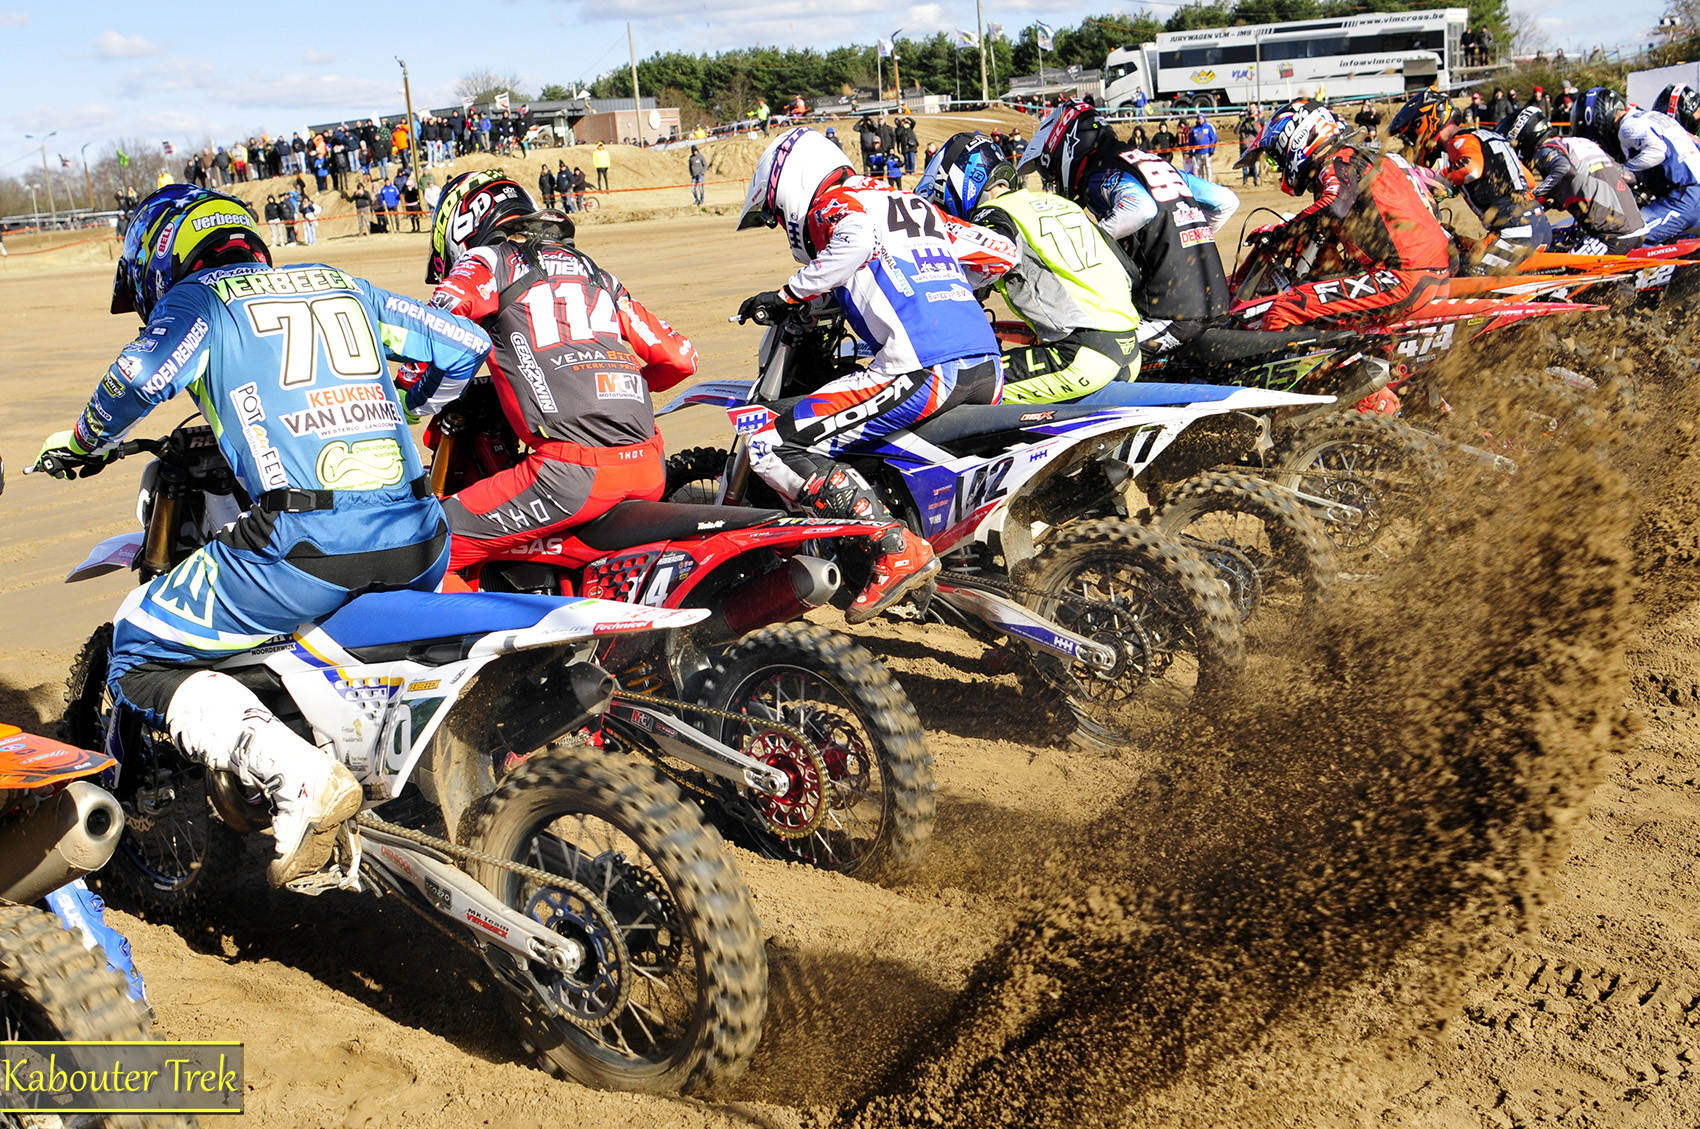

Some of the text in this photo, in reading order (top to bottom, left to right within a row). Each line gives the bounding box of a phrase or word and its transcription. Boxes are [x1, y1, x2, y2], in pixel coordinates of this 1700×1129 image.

[1360, 13, 1444, 25] www.vlmcross.be
[1170, 33, 1213, 42] JURYWAGEN
[1214, 31, 1230, 39] VLM
[191, 212, 253, 233] verbeeck
[434, 172, 494, 261] SCOTT
[452, 191, 493, 243] 6D
[887, 195, 946, 240] 42
[158, 225, 173, 254] BELL
[1038, 211, 1102, 273] 17
[1647, 246, 1678, 257] HONDA
[209, 269, 360, 305] VERBEECK
[893, 269, 913, 295] ACTIVE
[520, 282, 623, 349] 114
[247, 295, 381, 387] 70
[424, 312, 492, 355] RENDERS
[141, 317, 209, 395] KOEN RENDERS
[512, 332, 557, 412] GEAR2WIN
[572, 361, 605, 372] STERK
[309, 385, 385, 408] KEUKENS
[813, 374, 915, 442] JOPA
[284, 402, 402, 434] VAN LOMMEL
[320, 425, 360, 436] WESTERLO
[238, 385, 263, 421] POT
[262, 450, 286, 486] FEU
[245, 428, 260, 456] BISTRO
[251, 642, 296, 656] NOORDERWIJK
[466, 912, 509, 939] VERBEECK
